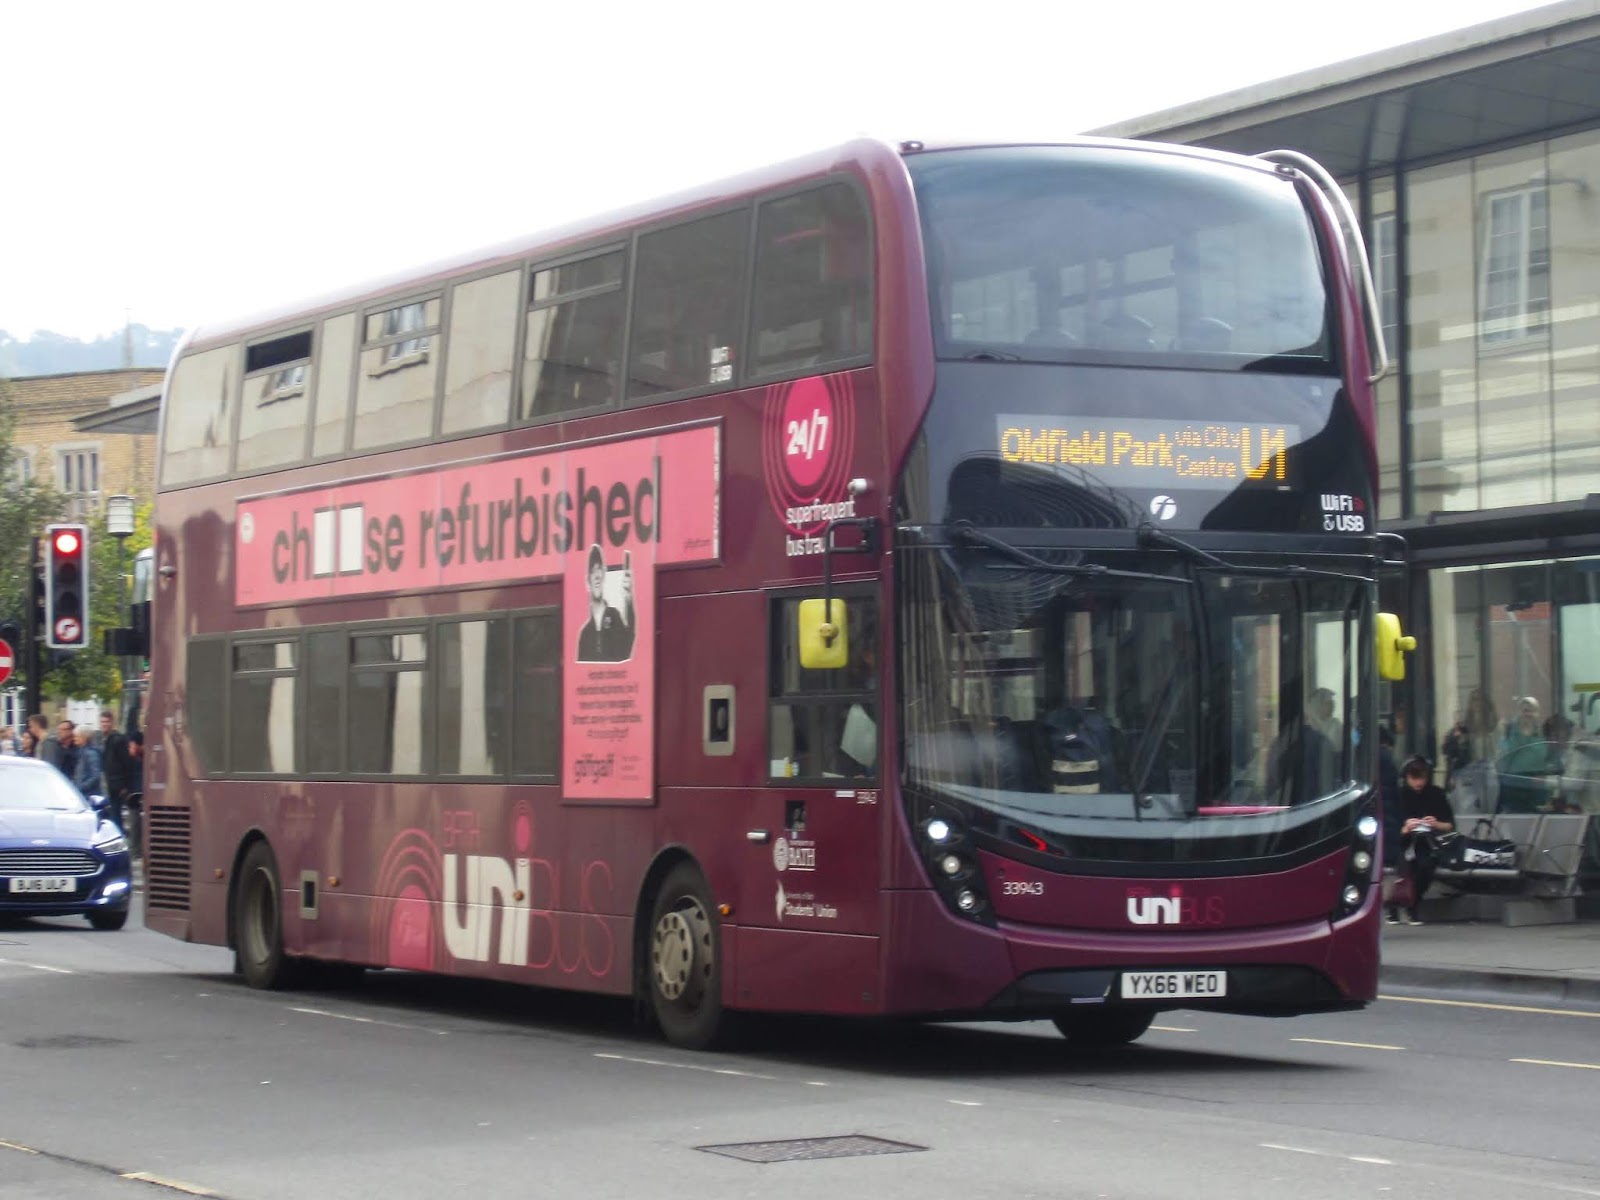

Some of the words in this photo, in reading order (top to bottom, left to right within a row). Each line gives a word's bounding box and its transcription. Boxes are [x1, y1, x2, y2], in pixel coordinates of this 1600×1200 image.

[787, 408, 829, 460] 24/7
[1175, 425, 1201, 447] via
[1205, 426, 1240, 448] City
[1002, 428, 1106, 464] Oldfield
[1113, 431, 1174, 466] Park
[1242, 427, 1285, 479] U1
[1177, 455, 1236, 477] Centre
[420, 455, 661, 569] refurbished
[1336, 514, 1364, 531] USB
[1003, 882, 1044, 895] 33943
[1131, 975, 1176, 994] YX66
[1184, 974, 1217, 993] WEO
